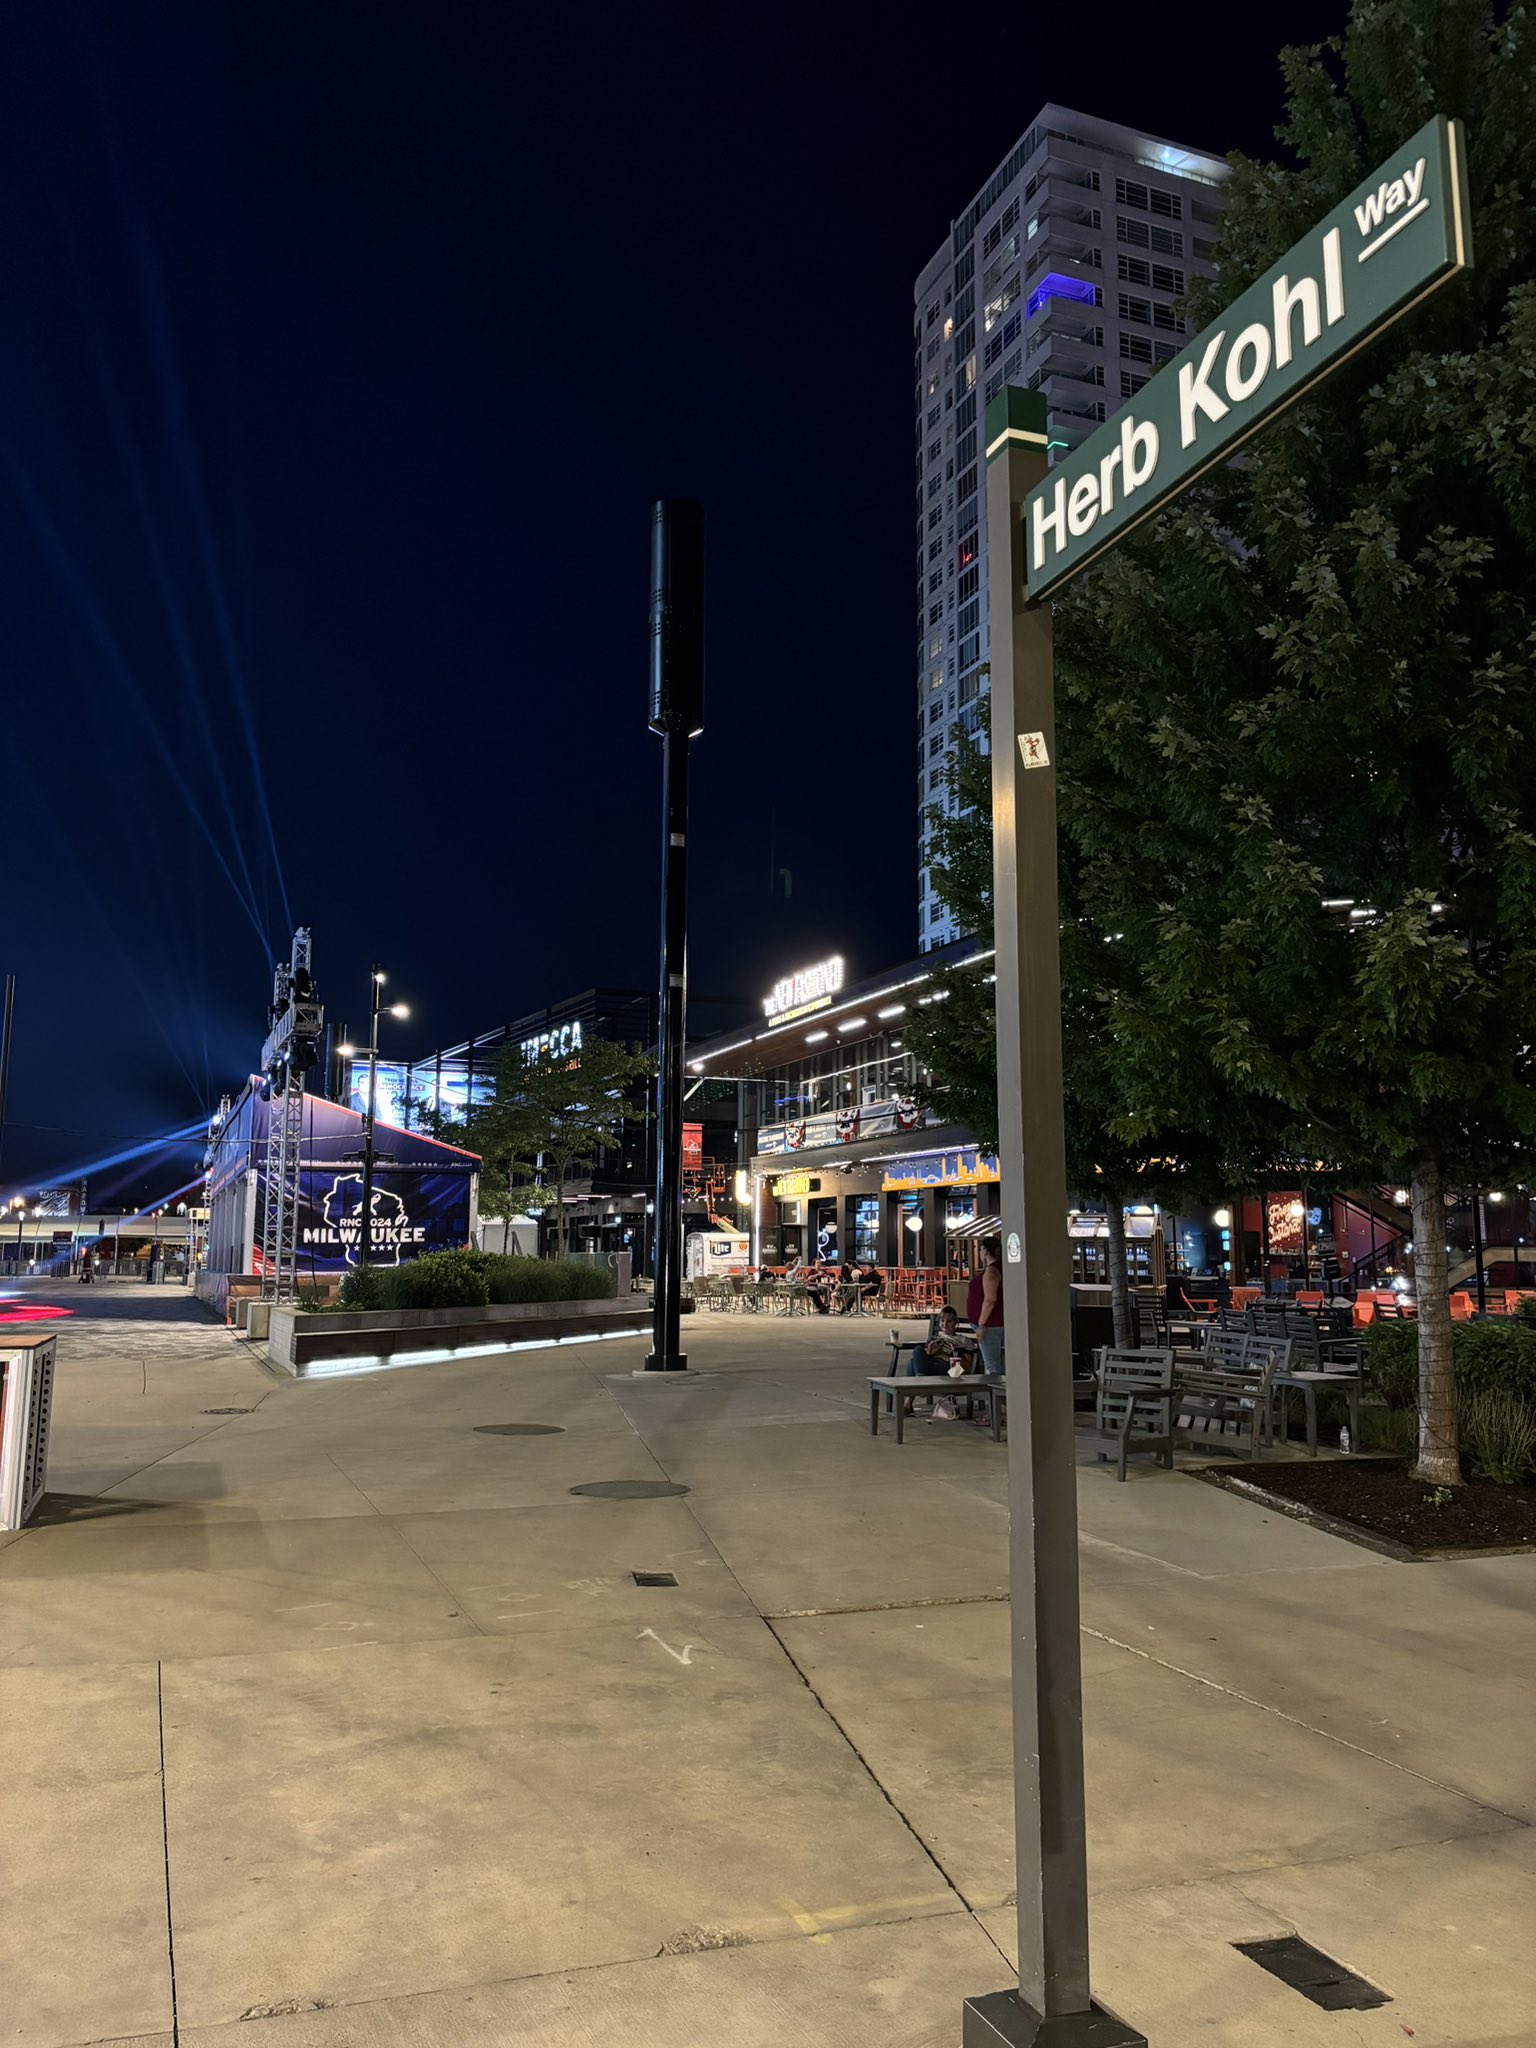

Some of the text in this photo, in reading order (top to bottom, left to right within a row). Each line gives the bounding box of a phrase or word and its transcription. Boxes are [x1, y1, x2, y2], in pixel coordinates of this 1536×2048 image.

[1032, 157, 1427, 571] Herb Kohl Way
[378, 1083, 425, 1092] DEMOCACY
[339, 1218, 392, 1227] RNC 024
[713, 1243, 730, 1254] Lite
